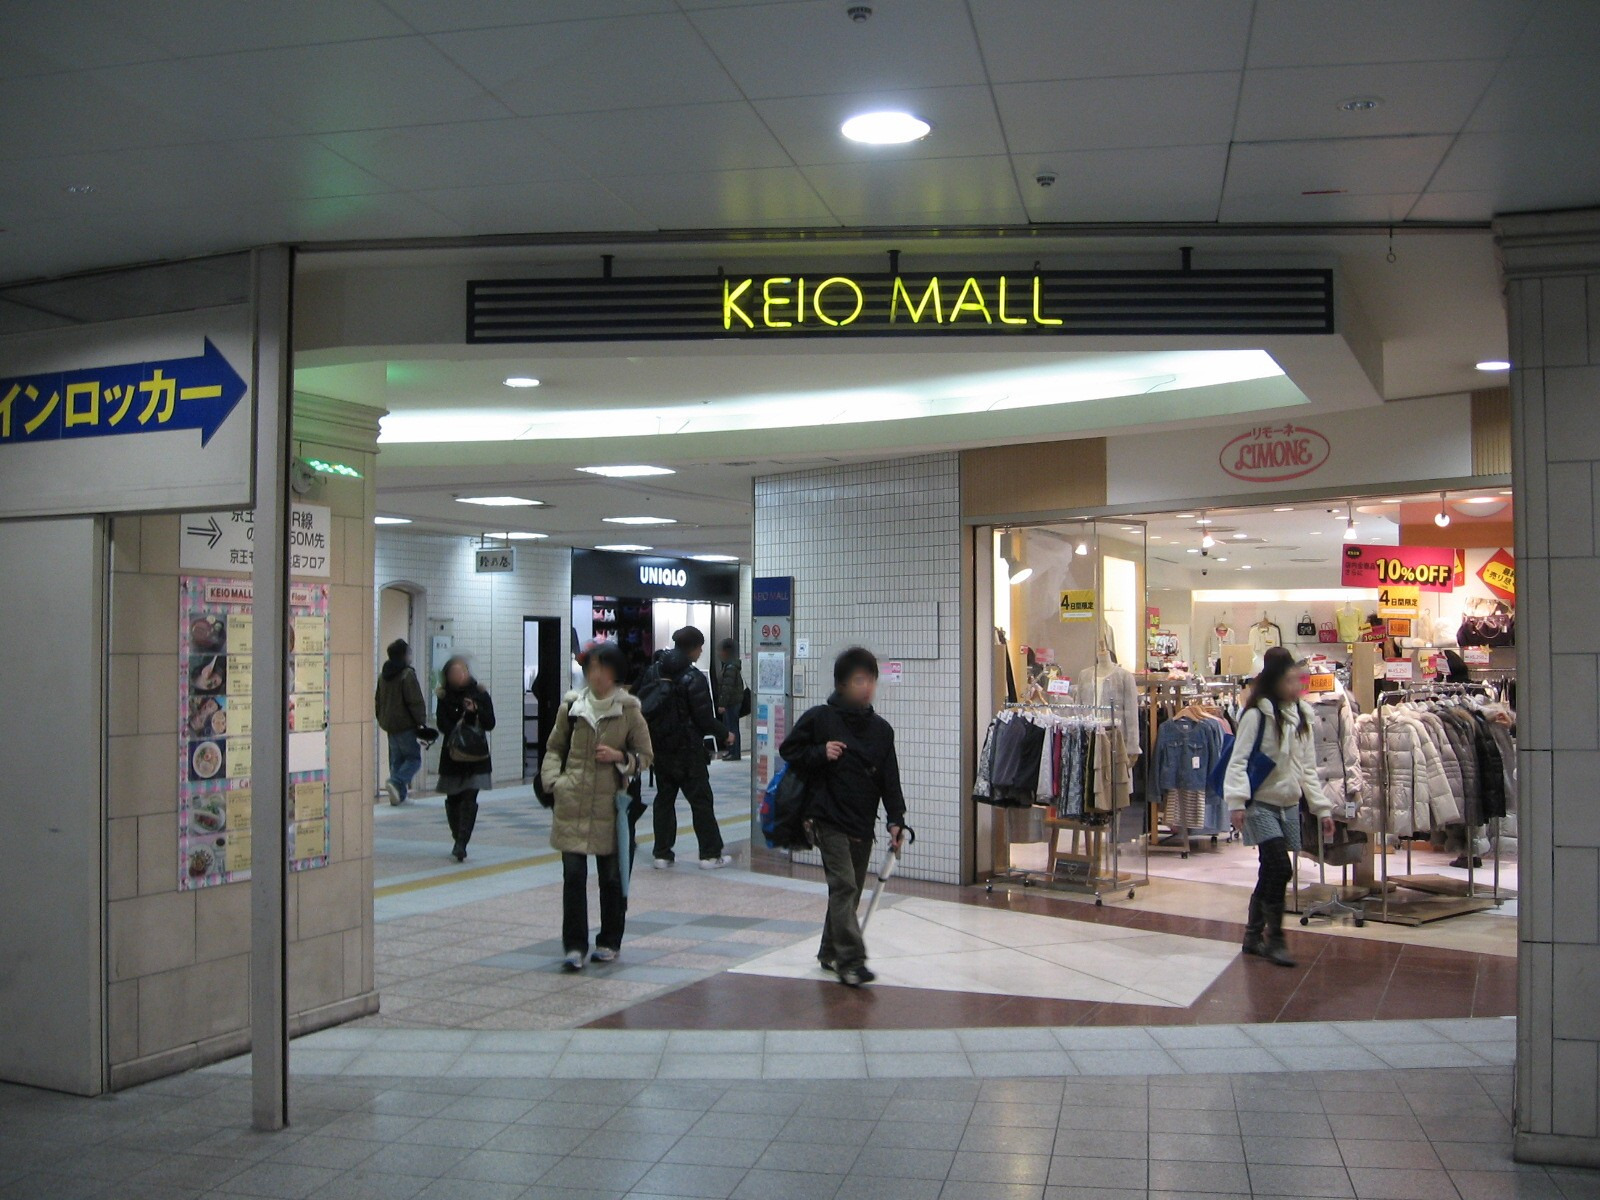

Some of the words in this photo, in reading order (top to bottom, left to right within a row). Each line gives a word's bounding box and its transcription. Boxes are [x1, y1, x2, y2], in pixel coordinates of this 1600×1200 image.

[723, 277, 863, 329] KEIO
[889, 276, 1063, 325] MALL
[0, 369, 222, 437] インロッカー
[1251, 424, 1294, 440] リモーネ
[1235, 439, 1313, 470] LIMONE
[290, 554, 326, 570] 店フロア
[1376, 558, 1450, 583] 10%OFF
[640, 565, 687, 587] UNIQLO
[210, 587, 230, 598] KEIO
[231, 589, 253, 599] MALL
[1061, 594, 1094, 610] 4日間限定
[1379, 589, 1418, 607] 4日間限定
